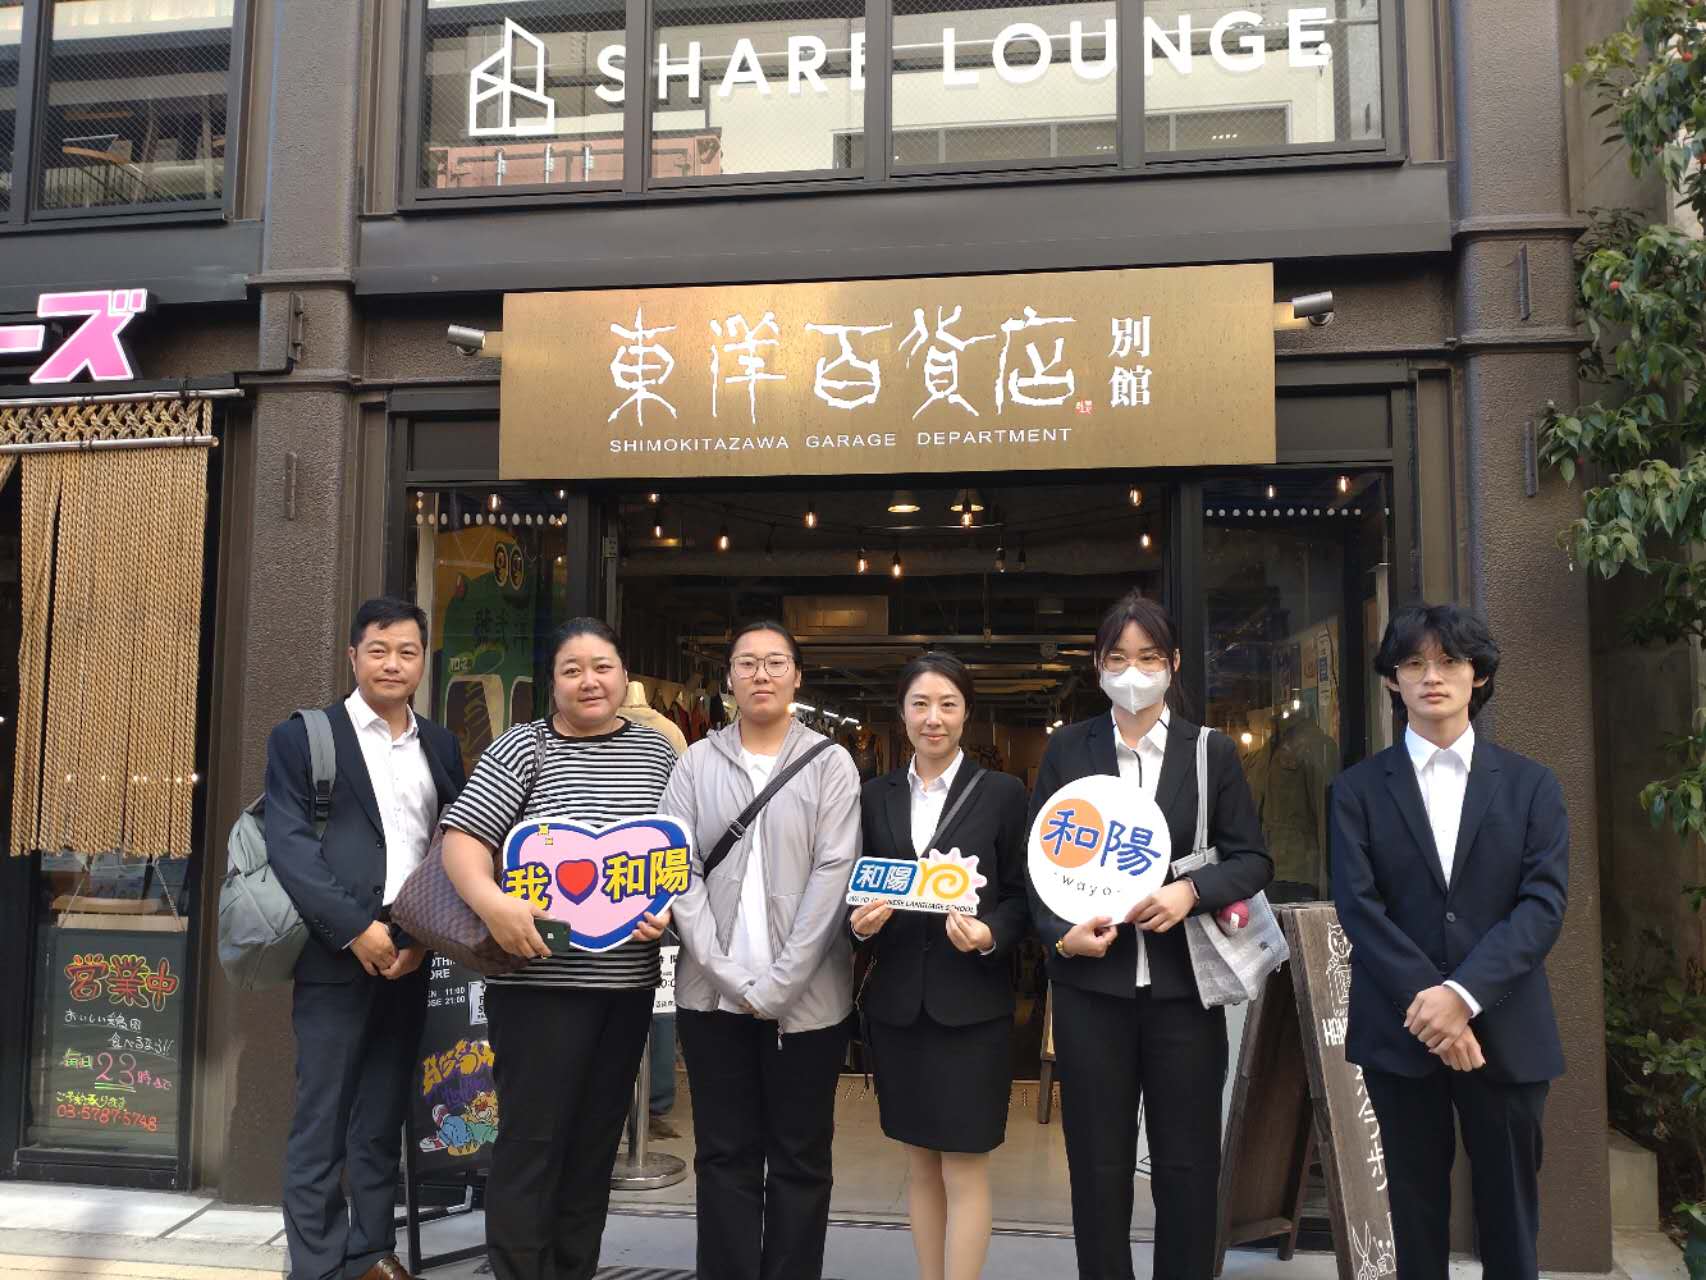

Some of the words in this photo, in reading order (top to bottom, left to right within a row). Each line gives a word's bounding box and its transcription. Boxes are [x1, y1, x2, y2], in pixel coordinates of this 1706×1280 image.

[942, 7, 1329, 87] LOUNGE
[607, 304, 1076, 425] 東洋百貨店
[1107, 314, 1153, 408] 別館
[609, 436, 790, 453] SHIMOKITAZAWA
[805, 433, 897, 449] GARAGE
[917, 428, 1072, 446] DEPARTMENT
[1042, 808, 1162, 876] 和陽
[503, 862, 552, 911] 我
[602, 845, 691, 904] 和陽
[856, 864, 913, 891] 和陽
[64, 953, 180, 1012] 営業中
